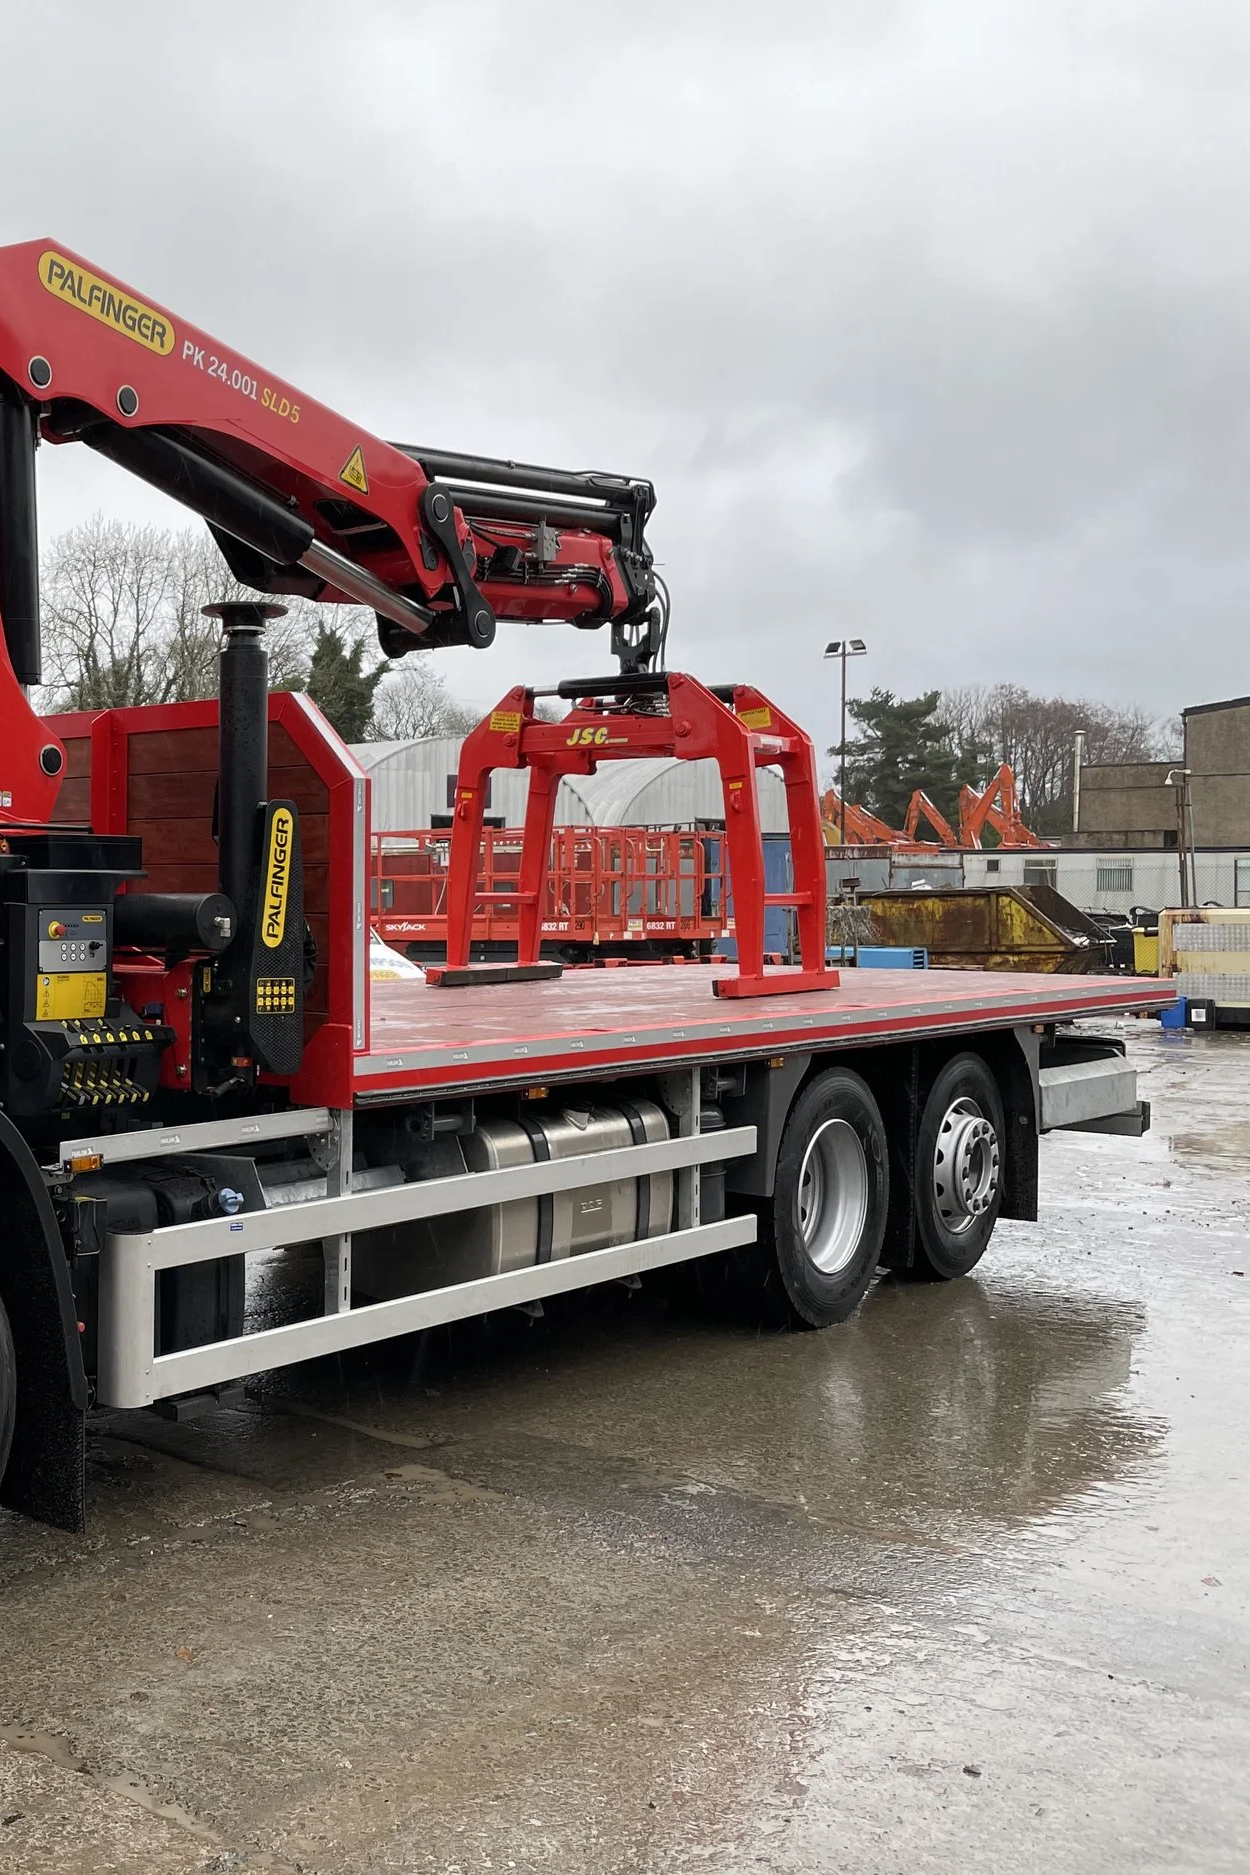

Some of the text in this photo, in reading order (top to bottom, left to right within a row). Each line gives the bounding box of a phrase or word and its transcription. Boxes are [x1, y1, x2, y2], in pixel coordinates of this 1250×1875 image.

[47, 258, 167, 349] PALFINGER
[182, 340, 206, 370] PK
[207, 356, 258, 401] 24.001
[566, 727, 608, 746] JSC
[266, 817, 289, 939] PALFINGER
[385, 921, 426, 932] SKYJACK
[646, 921, 664, 930] 6832
